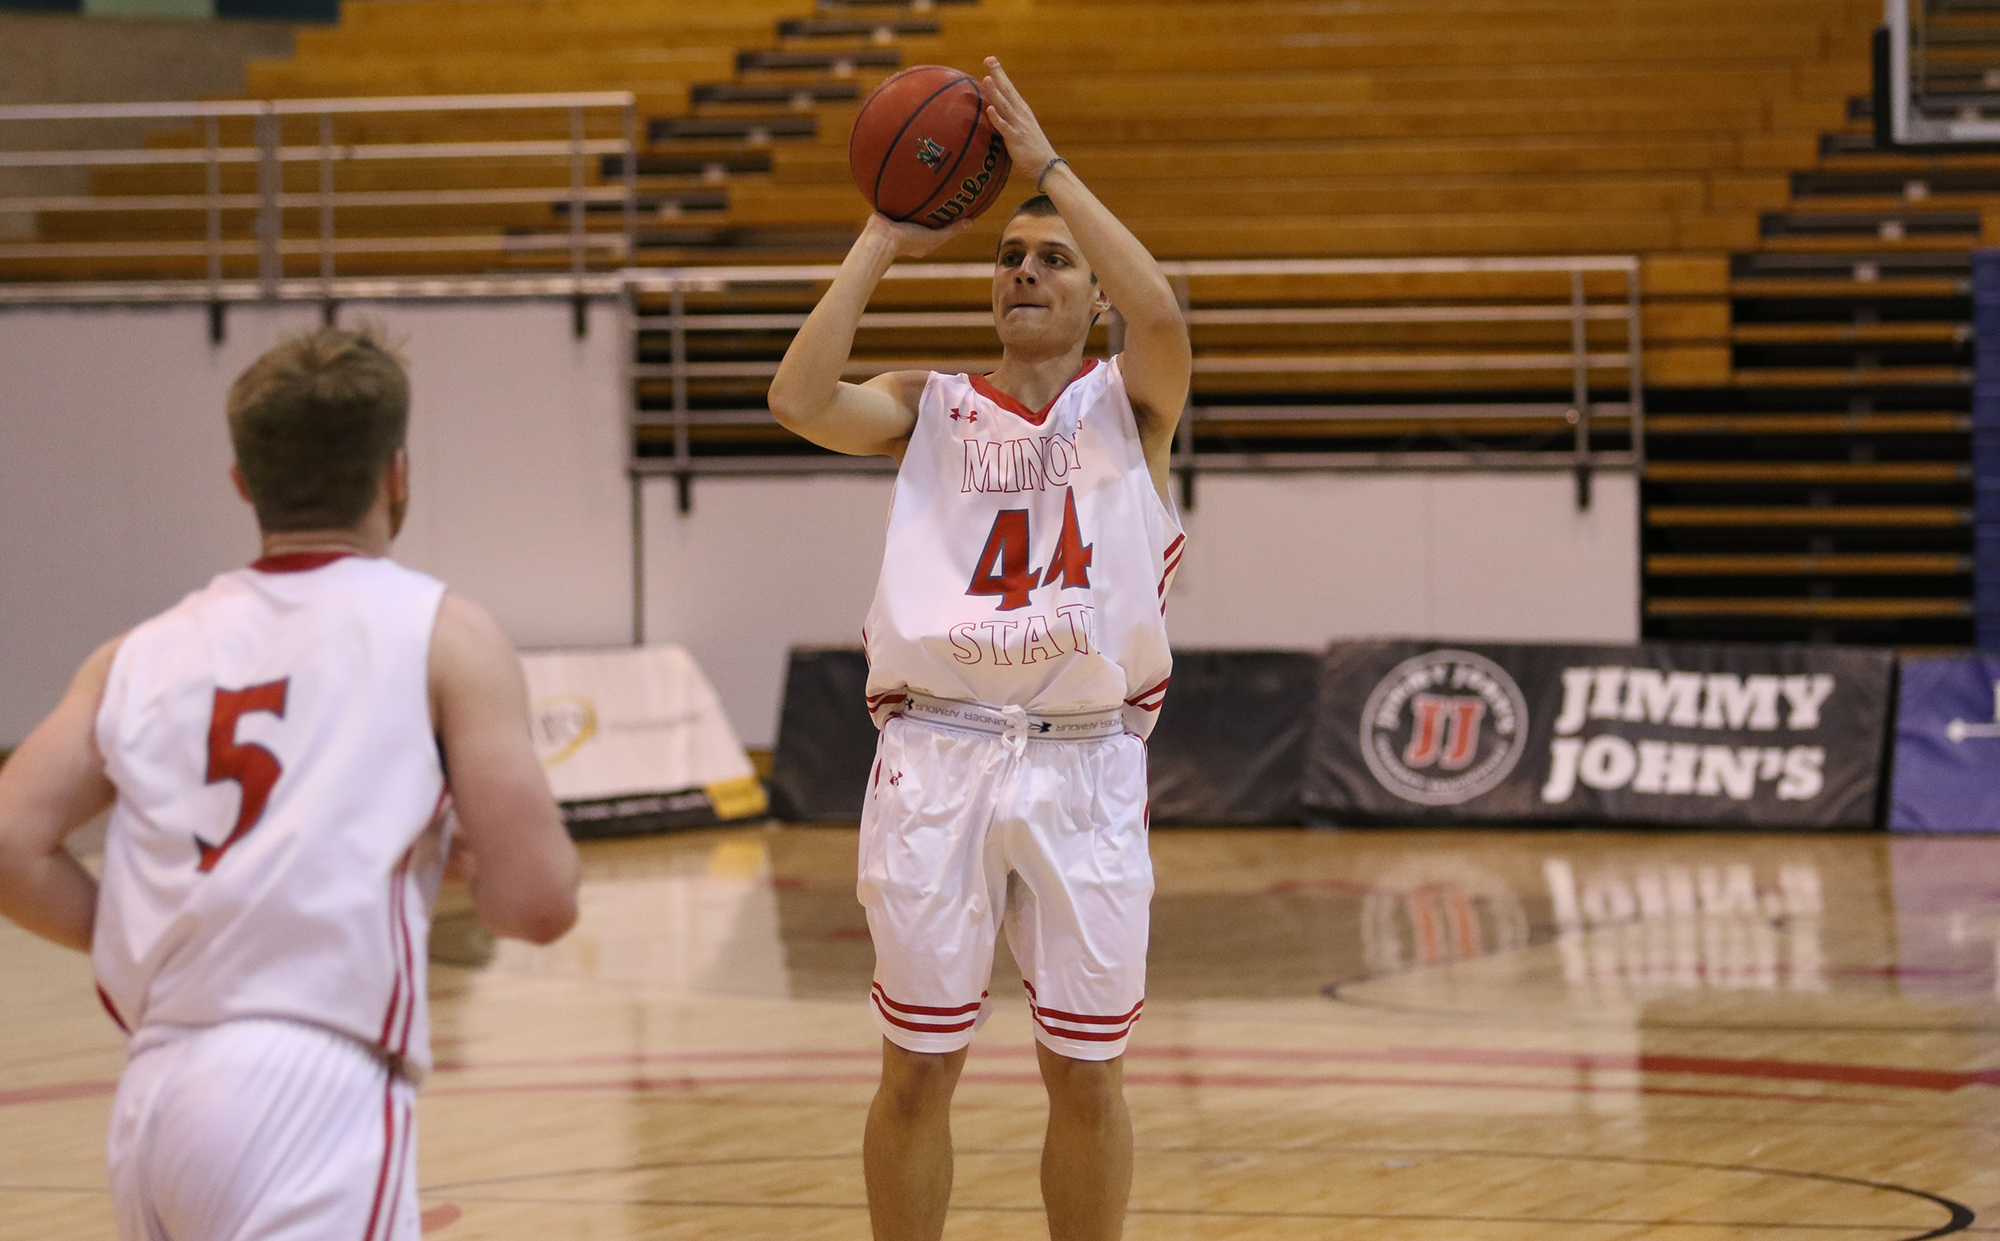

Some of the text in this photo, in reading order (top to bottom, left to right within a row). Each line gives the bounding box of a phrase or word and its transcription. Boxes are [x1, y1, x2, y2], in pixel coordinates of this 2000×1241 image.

[926, 132, 1004, 224] Wilson
[964, 484, 1094, 611] 44
[915, 703, 960, 718] ARMOUR
[1056, 721, 1099, 732] ARMOUR
[1402, 692, 1487, 771] JJ
[1554, 666, 1836, 735] JIMMY
[193, 674, 290, 873] 5
[1541, 734, 1827, 803] JOHN'S
